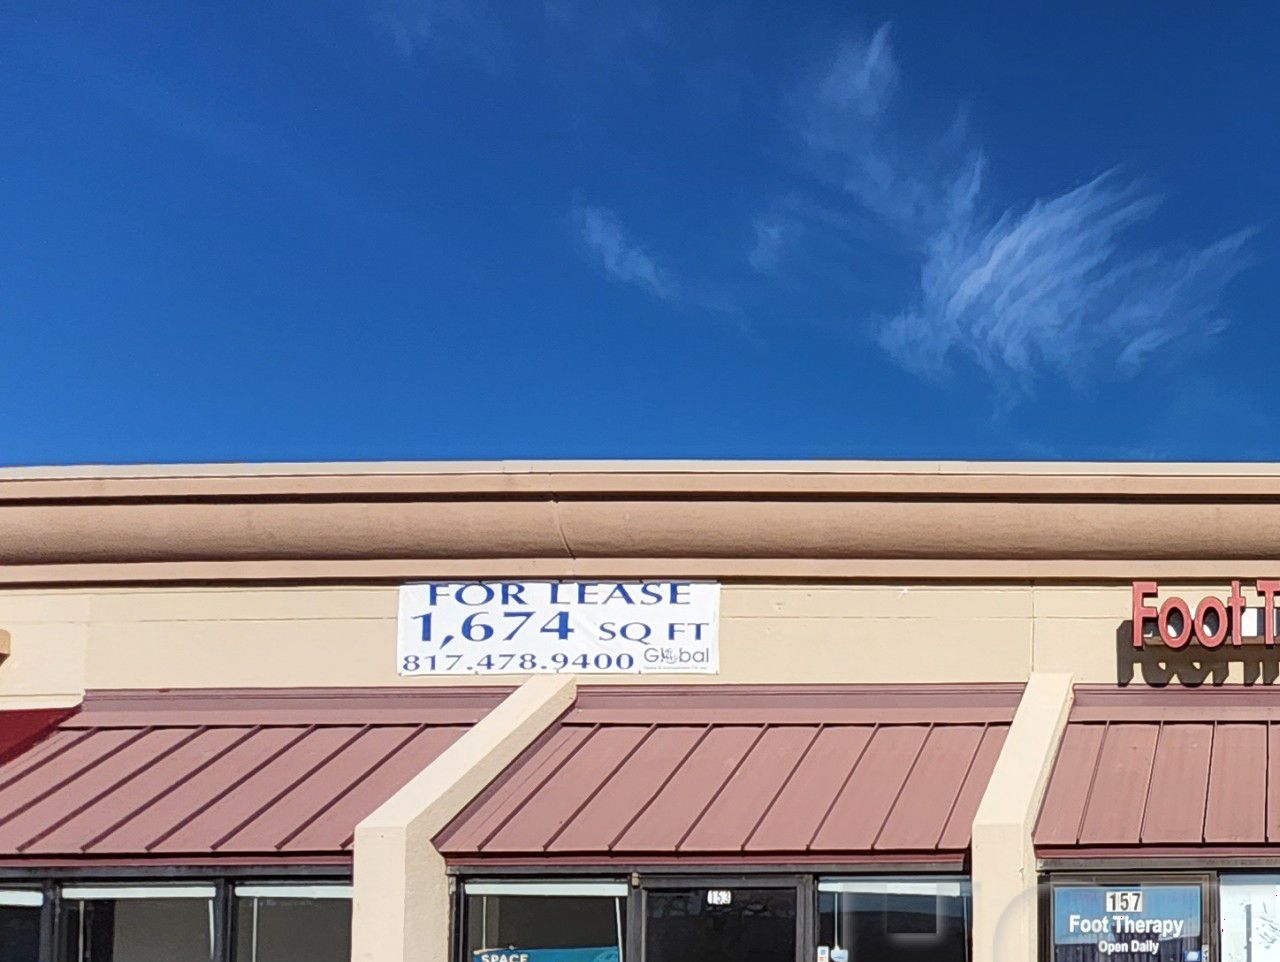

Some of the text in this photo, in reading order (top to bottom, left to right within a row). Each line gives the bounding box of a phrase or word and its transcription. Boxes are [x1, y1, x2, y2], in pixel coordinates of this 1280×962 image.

[429, 583, 690, 606] FOR LEASE
[1132, 580, 1246, 649] Foot
[411, 611, 575, 649] 1,674
[598, 622, 710, 645] SQ FT
[402, 653, 635, 671] 817.478.9400
[1108, 892, 1141, 912] 157
[1069, 915, 1184, 937] Foot Therapy
[1099, 940, 1159, 955] Open Daily
